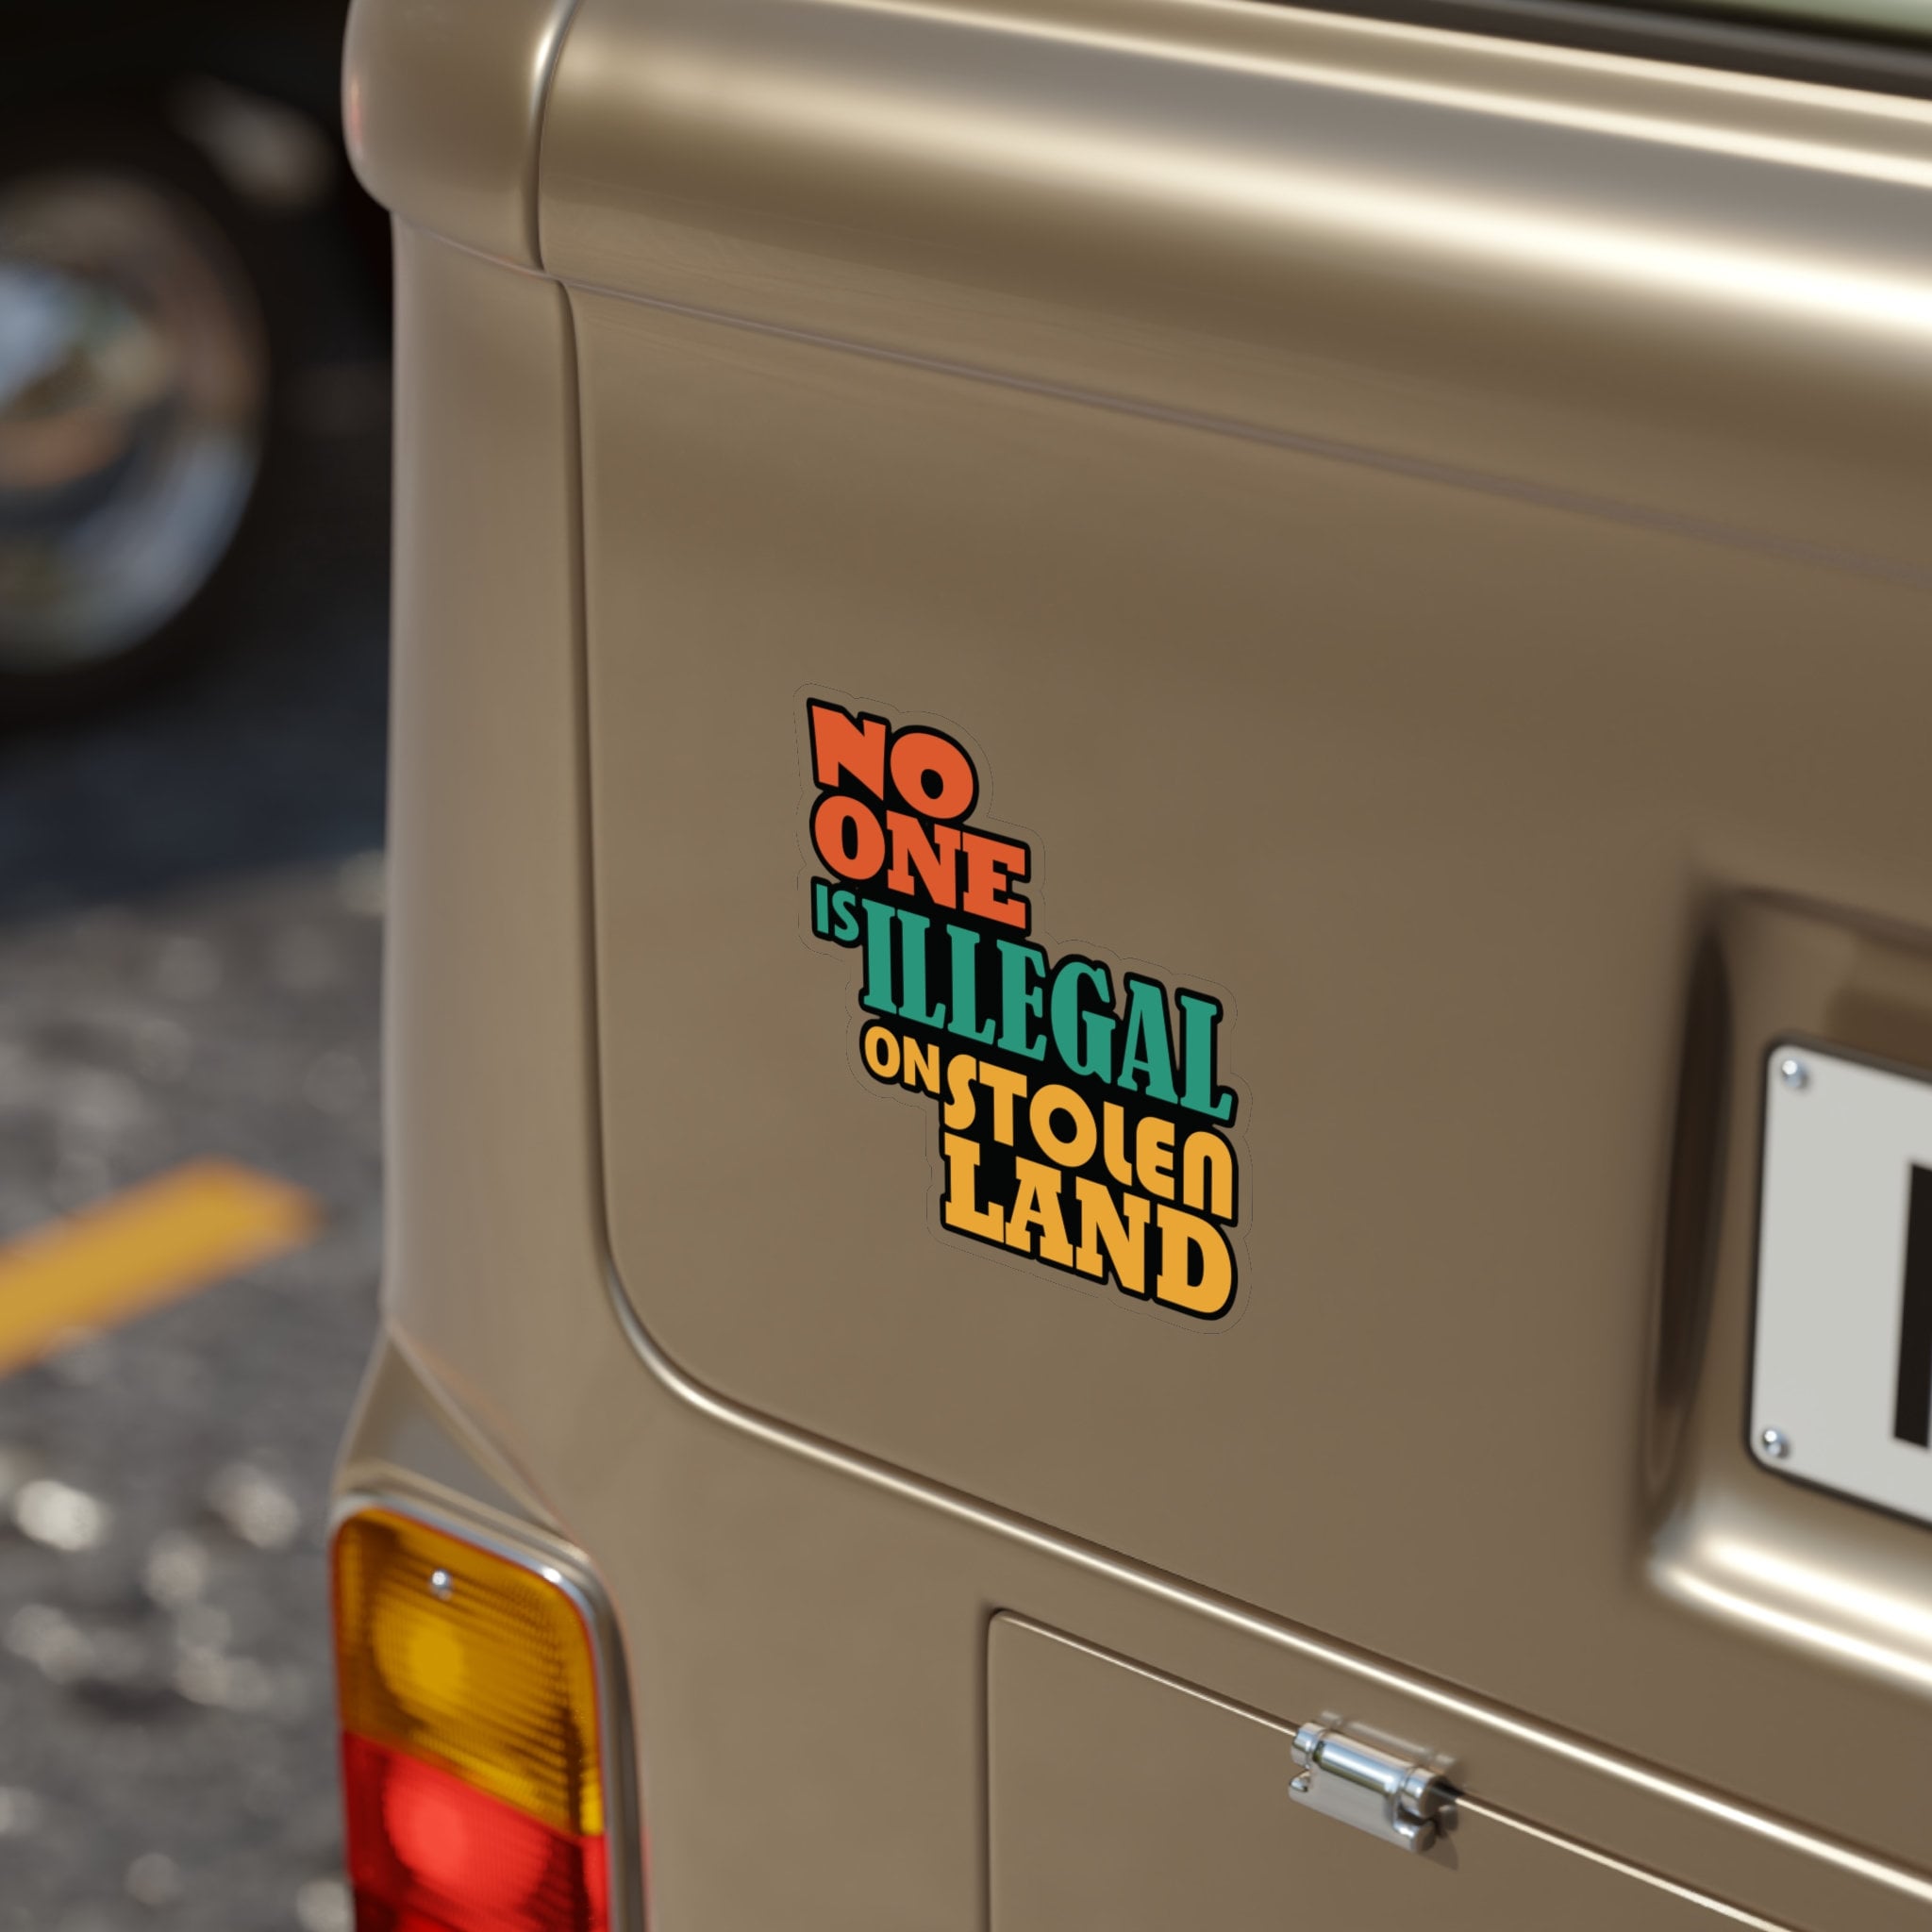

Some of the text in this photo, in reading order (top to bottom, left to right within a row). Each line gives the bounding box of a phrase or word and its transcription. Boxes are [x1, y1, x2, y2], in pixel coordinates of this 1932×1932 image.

[811, 705, 974, 819] NO
[814, 795, 1026, 929] ONE
[816, 883, 1233, 1121] IS ILLEGAL
[864, 1025, 1233, 1220] ON STOLEN
[944, 1132, 1232, 1313] LAND
